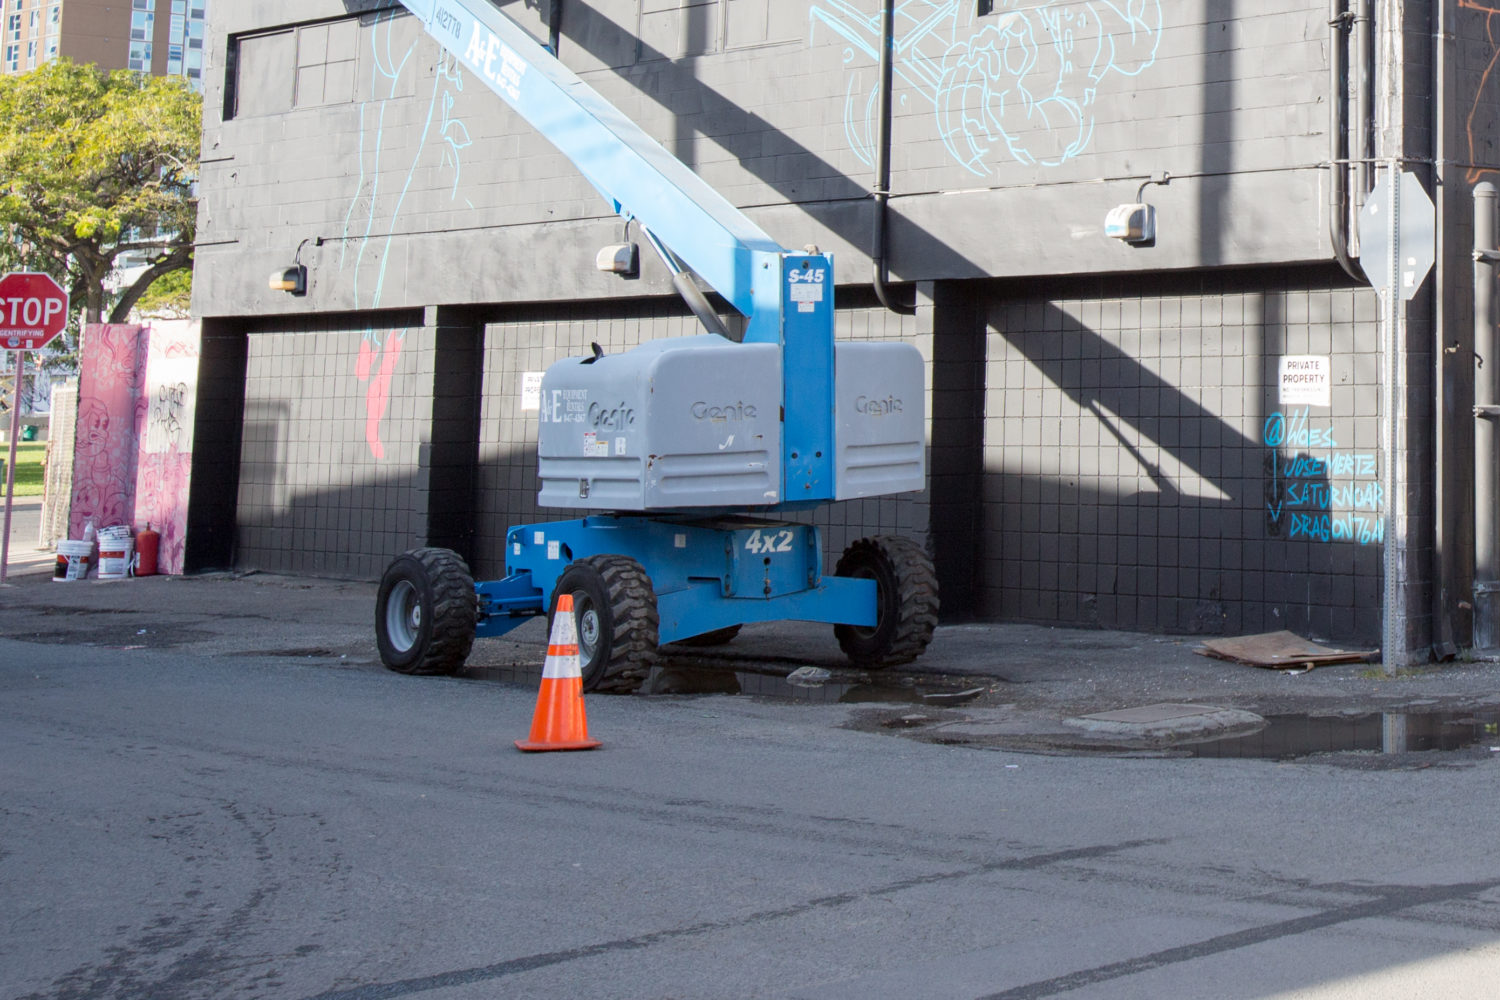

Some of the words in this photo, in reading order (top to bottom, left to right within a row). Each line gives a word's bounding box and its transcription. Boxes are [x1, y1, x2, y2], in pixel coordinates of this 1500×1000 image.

[788, 269, 825, 283] S-45
[1287, 361, 1320, 370] PRIVATE
[1283, 374, 1325, 383] PROPERTY
[541, 389, 562, 423] A&E
[690, 401, 758, 422] Genie
[855, 395, 904, 416] Genie
[1284, 450, 1376, 477] JOSEMERTZ
[745, 529, 794, 554] 4x2
